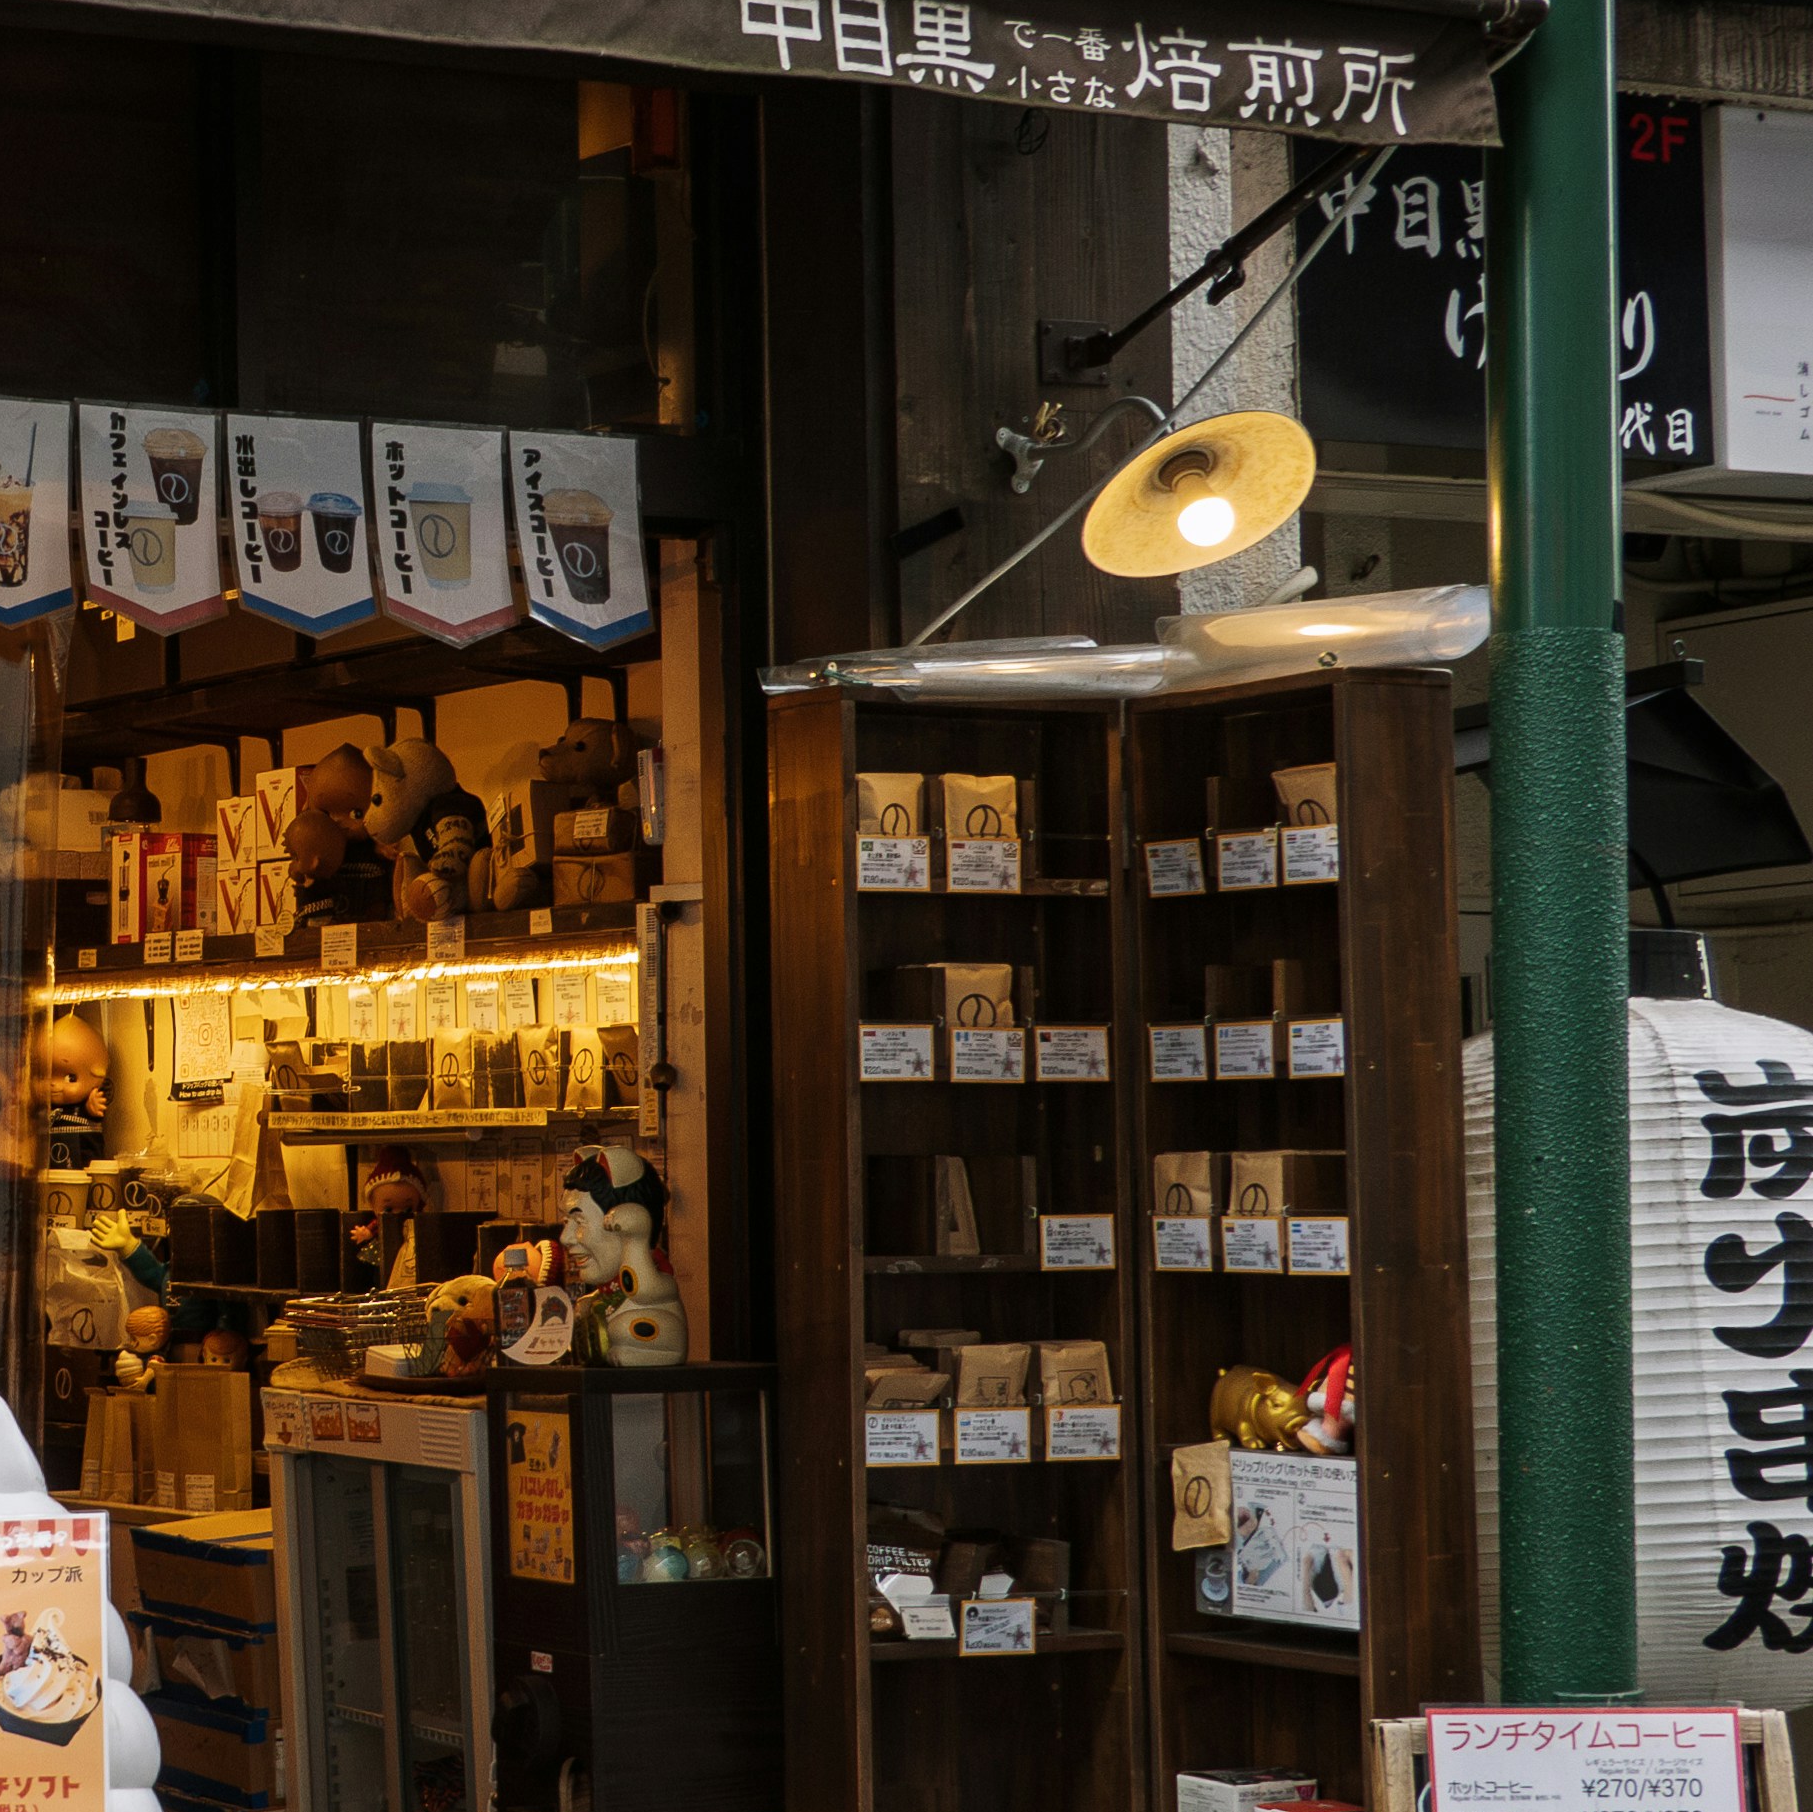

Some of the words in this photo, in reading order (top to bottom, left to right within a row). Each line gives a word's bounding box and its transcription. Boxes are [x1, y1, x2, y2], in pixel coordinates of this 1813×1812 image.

[1004, 19, 1114, 63] で一番
[1006, 67, 1116, 110] 小さな
[1121, 22, 1416, 137] 焙煎所
[1629, 112, 1689, 164] 2F
[108, 410, 133, 552] カフェインレス
[234, 433, 264, 585] 水出しコーヒー
[384, 440, 413, 595] ホットコーヒー
[522, 448, 556, 598] アイスコーヒー
[94, 510, 114, 587] コーヒー
[10, 1564, 85, 1585] カップ派
[866, 1543, 906, 1558] COFFEE
[867, 1555, 893, 1566] DRIP
[894, 1556, 933, 1568] FILTER
[1444, 1720, 1727, 1752] ランチタイムコーヒー
[1447, 1780, 1534, 1794] ホットコーヒー
[1581, 1778, 1703, 1801] ¥270/¥370
